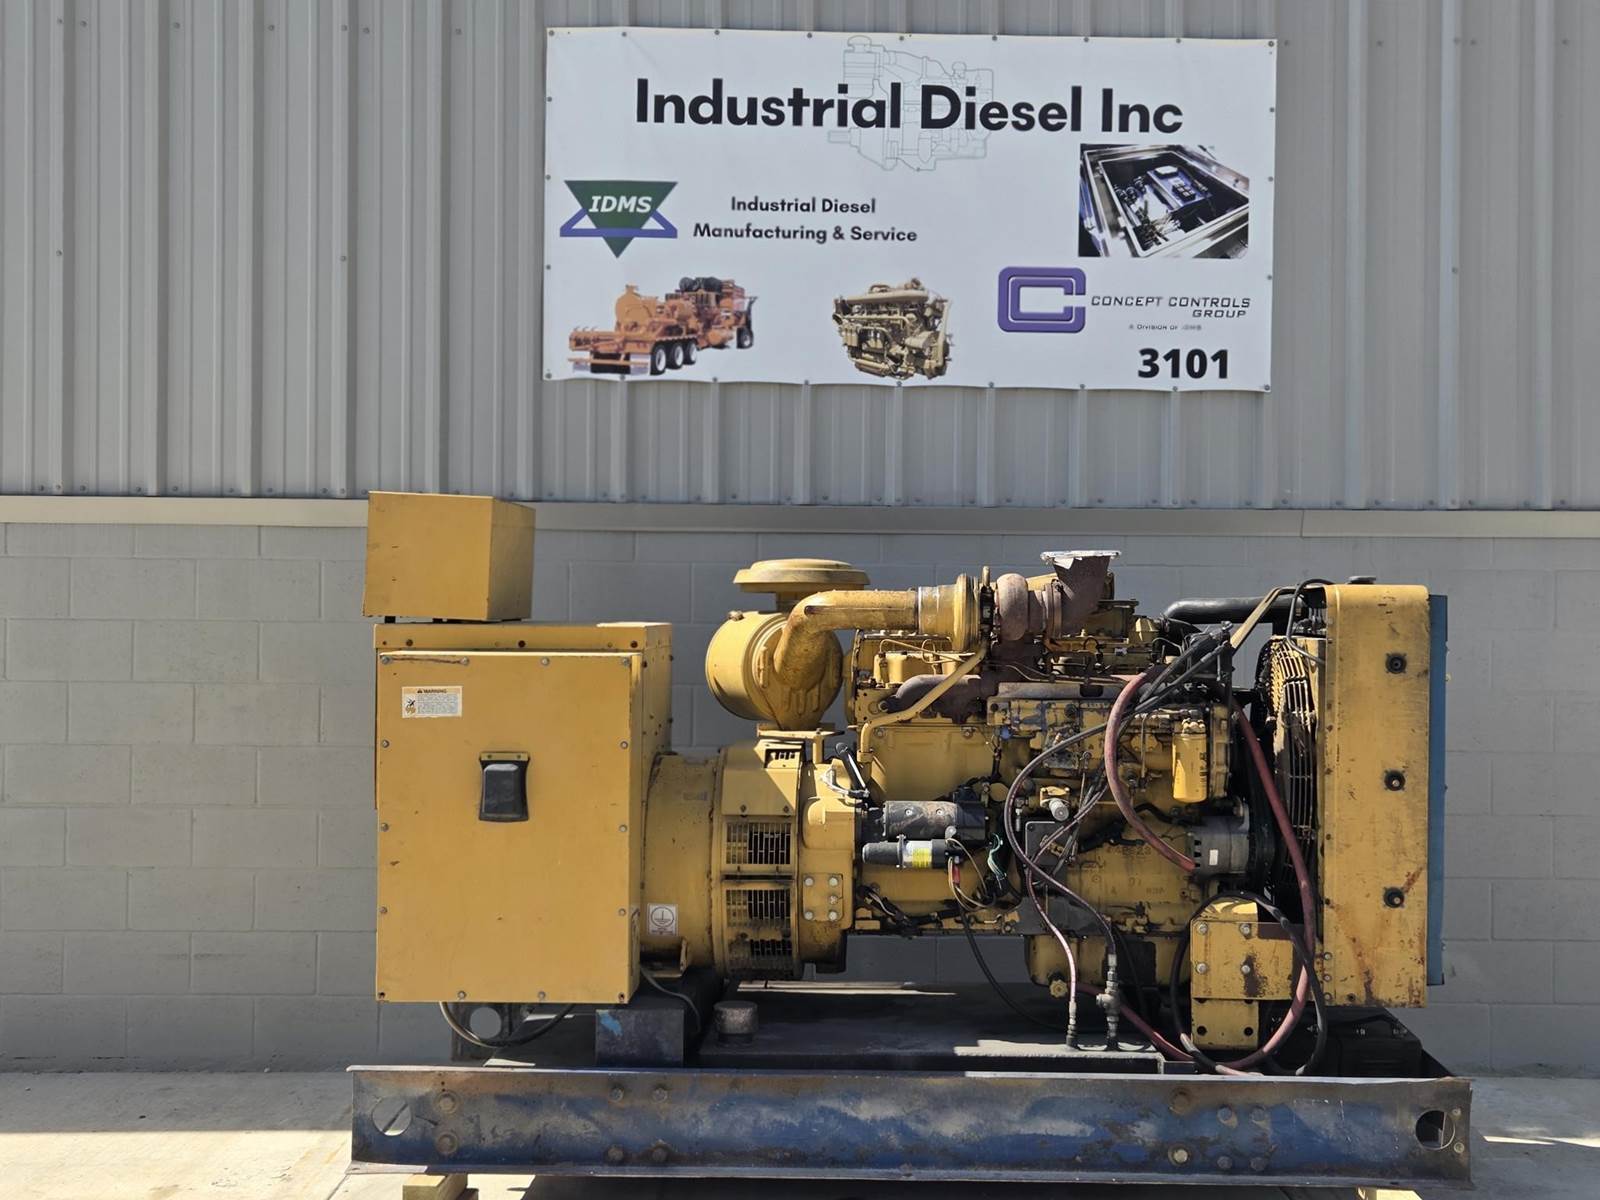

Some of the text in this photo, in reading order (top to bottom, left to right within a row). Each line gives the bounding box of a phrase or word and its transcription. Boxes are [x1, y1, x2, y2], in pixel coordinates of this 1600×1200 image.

[636, 77, 1184, 134] Industrial Diesel Inc
[588, 195, 653, 214] IDMS
[731, 195, 877, 214] Industrial Diesel
[692, 222, 918, 245] Manufacturing & Service
[1090, 295, 1251, 308] CONCEPT CONTROLS
[1192, 309, 1247, 318] GROUP
[1137, 347, 1229, 380] 3101
